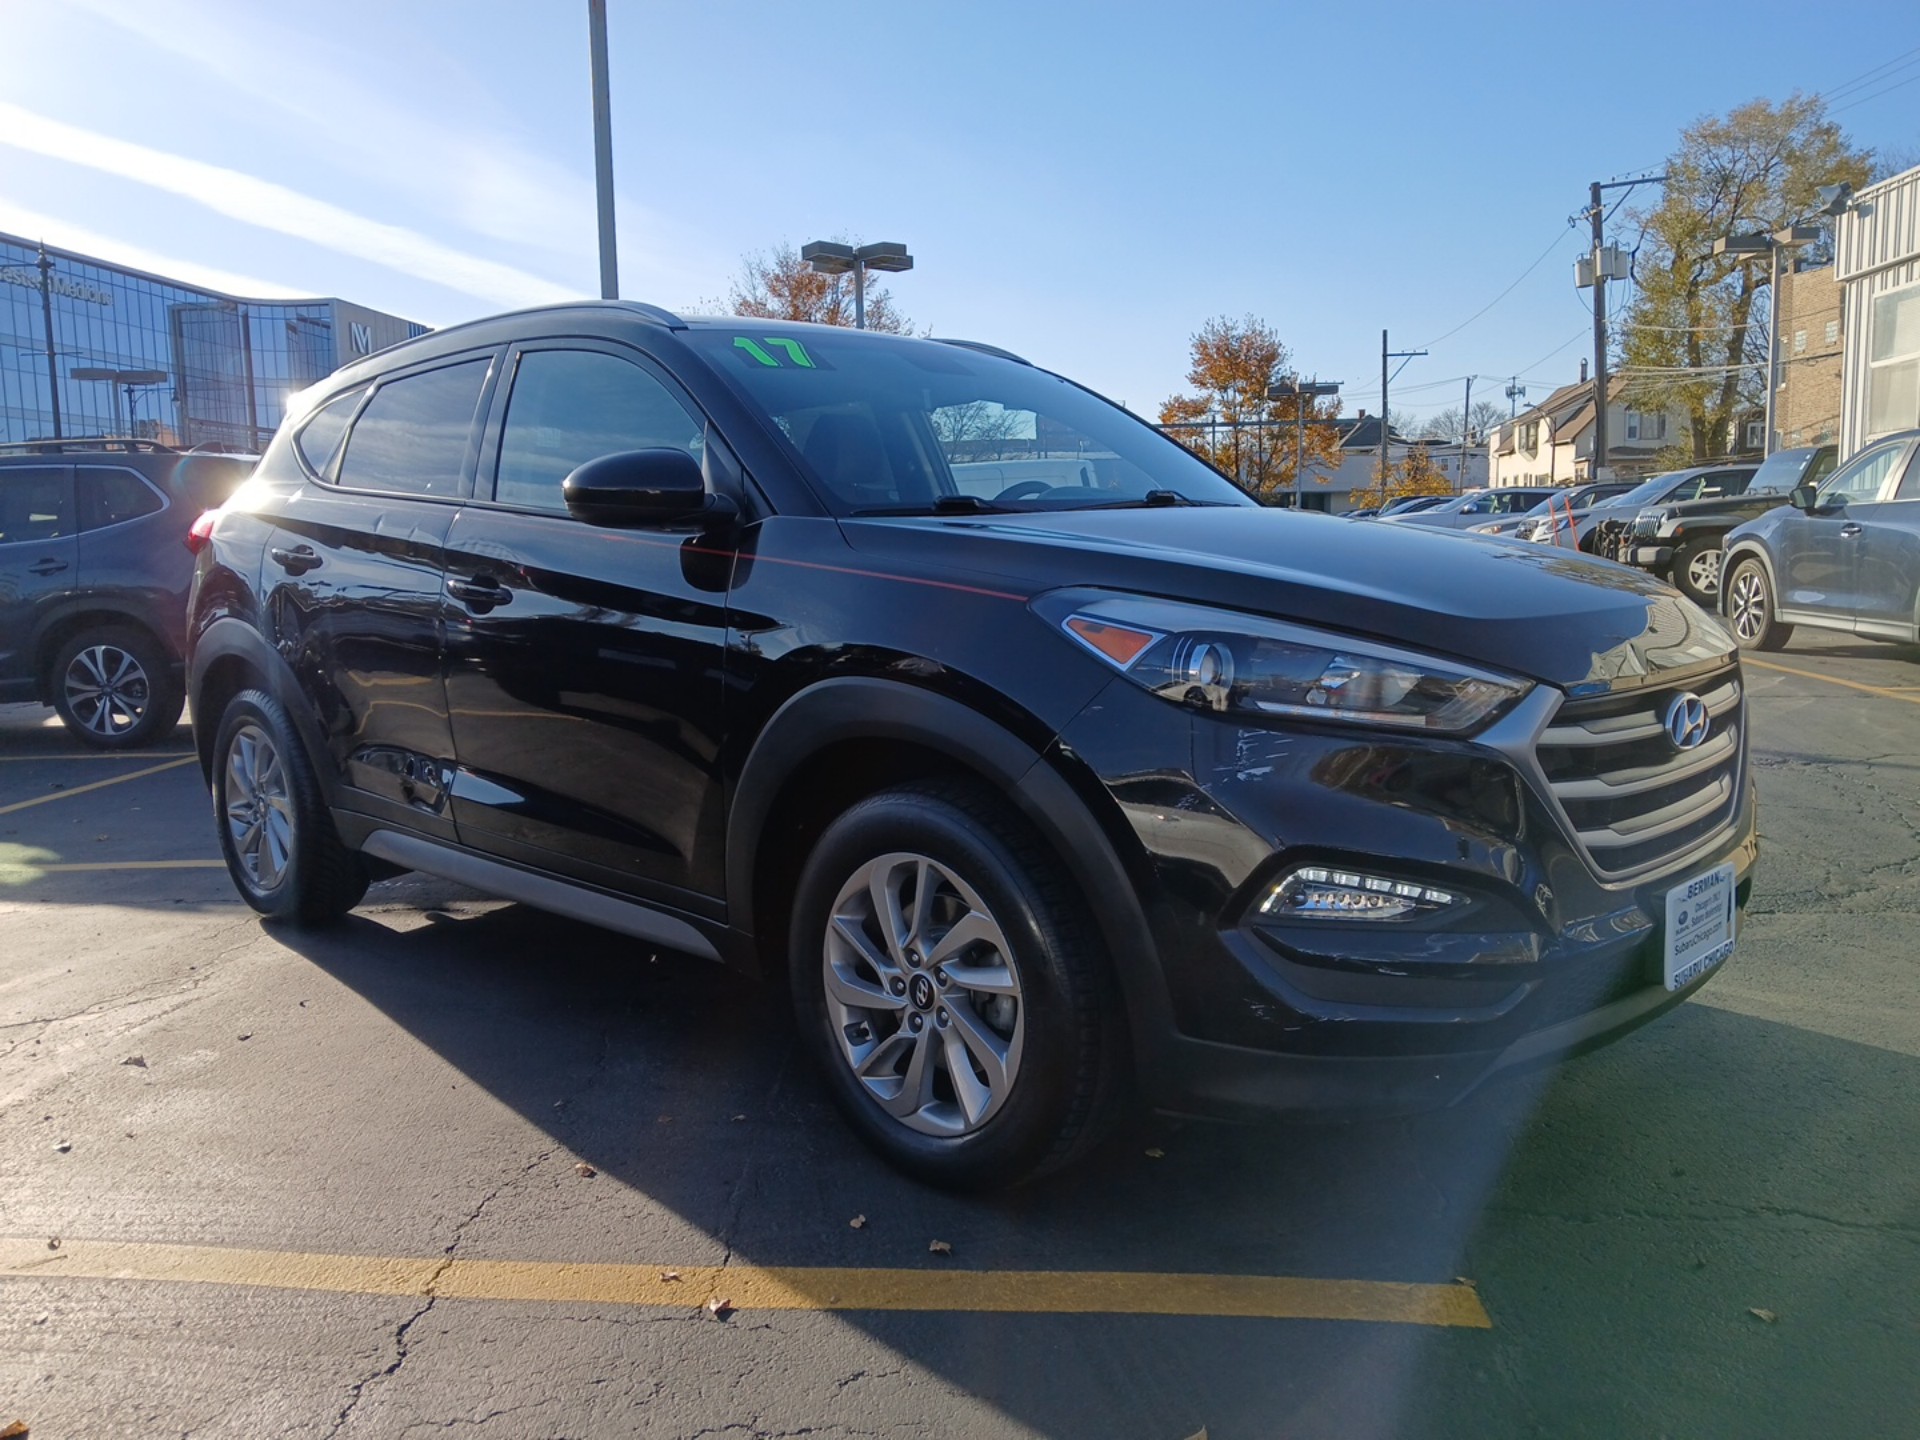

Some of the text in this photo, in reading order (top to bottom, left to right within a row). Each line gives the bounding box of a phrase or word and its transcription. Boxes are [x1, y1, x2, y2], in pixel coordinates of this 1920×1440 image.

[733, 337, 816, 368] 17
[1687, 872, 1721, 899] BERMAN
[1674, 941, 1734, 989] SUBARU CHICAGO
